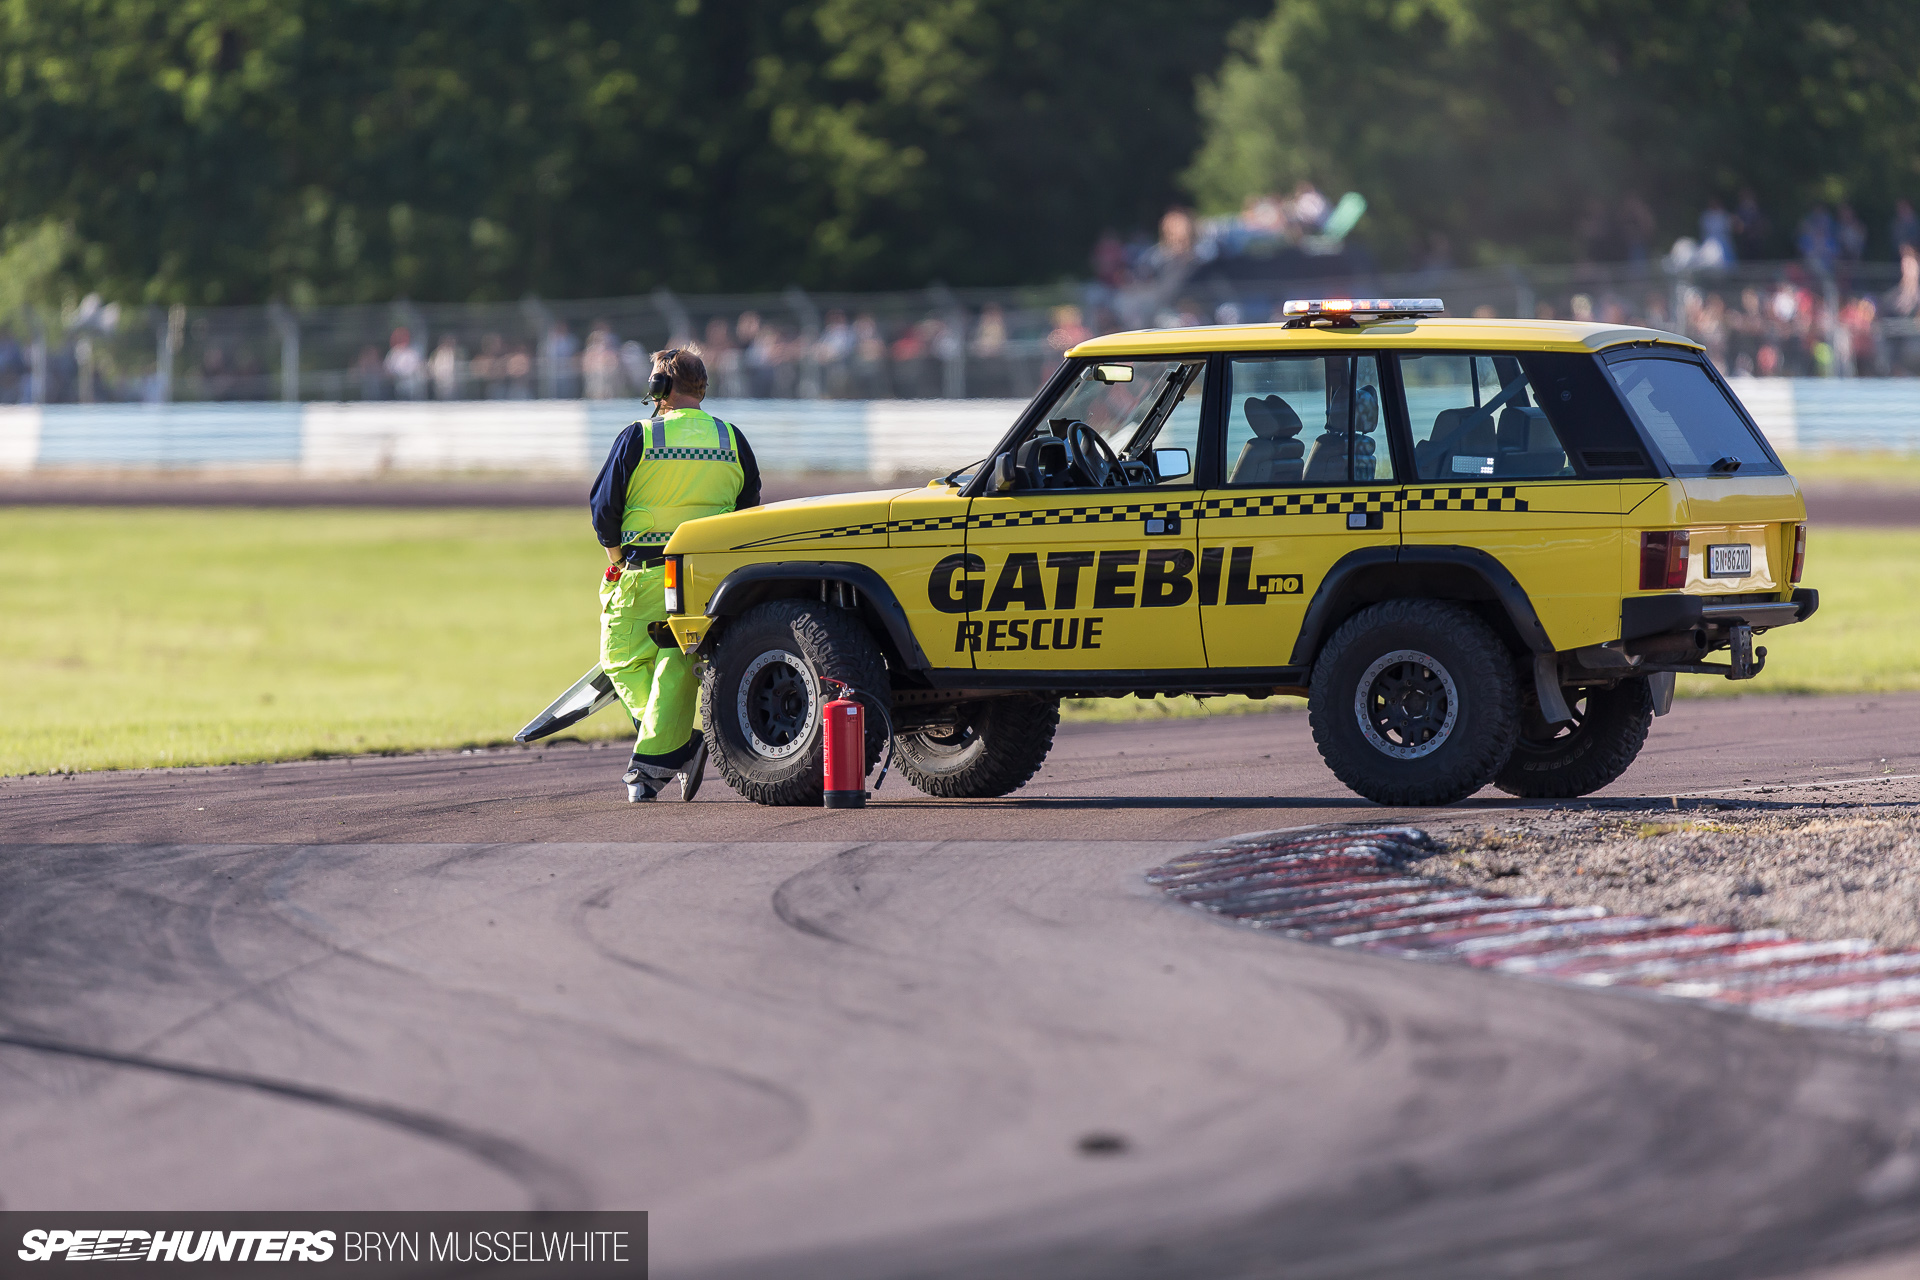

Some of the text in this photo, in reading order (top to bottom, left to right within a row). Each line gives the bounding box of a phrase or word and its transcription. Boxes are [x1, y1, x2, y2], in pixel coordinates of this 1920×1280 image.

[1715, 549, 1749, 571] BN 86200
[954, 617, 1103, 653] RESCUE
